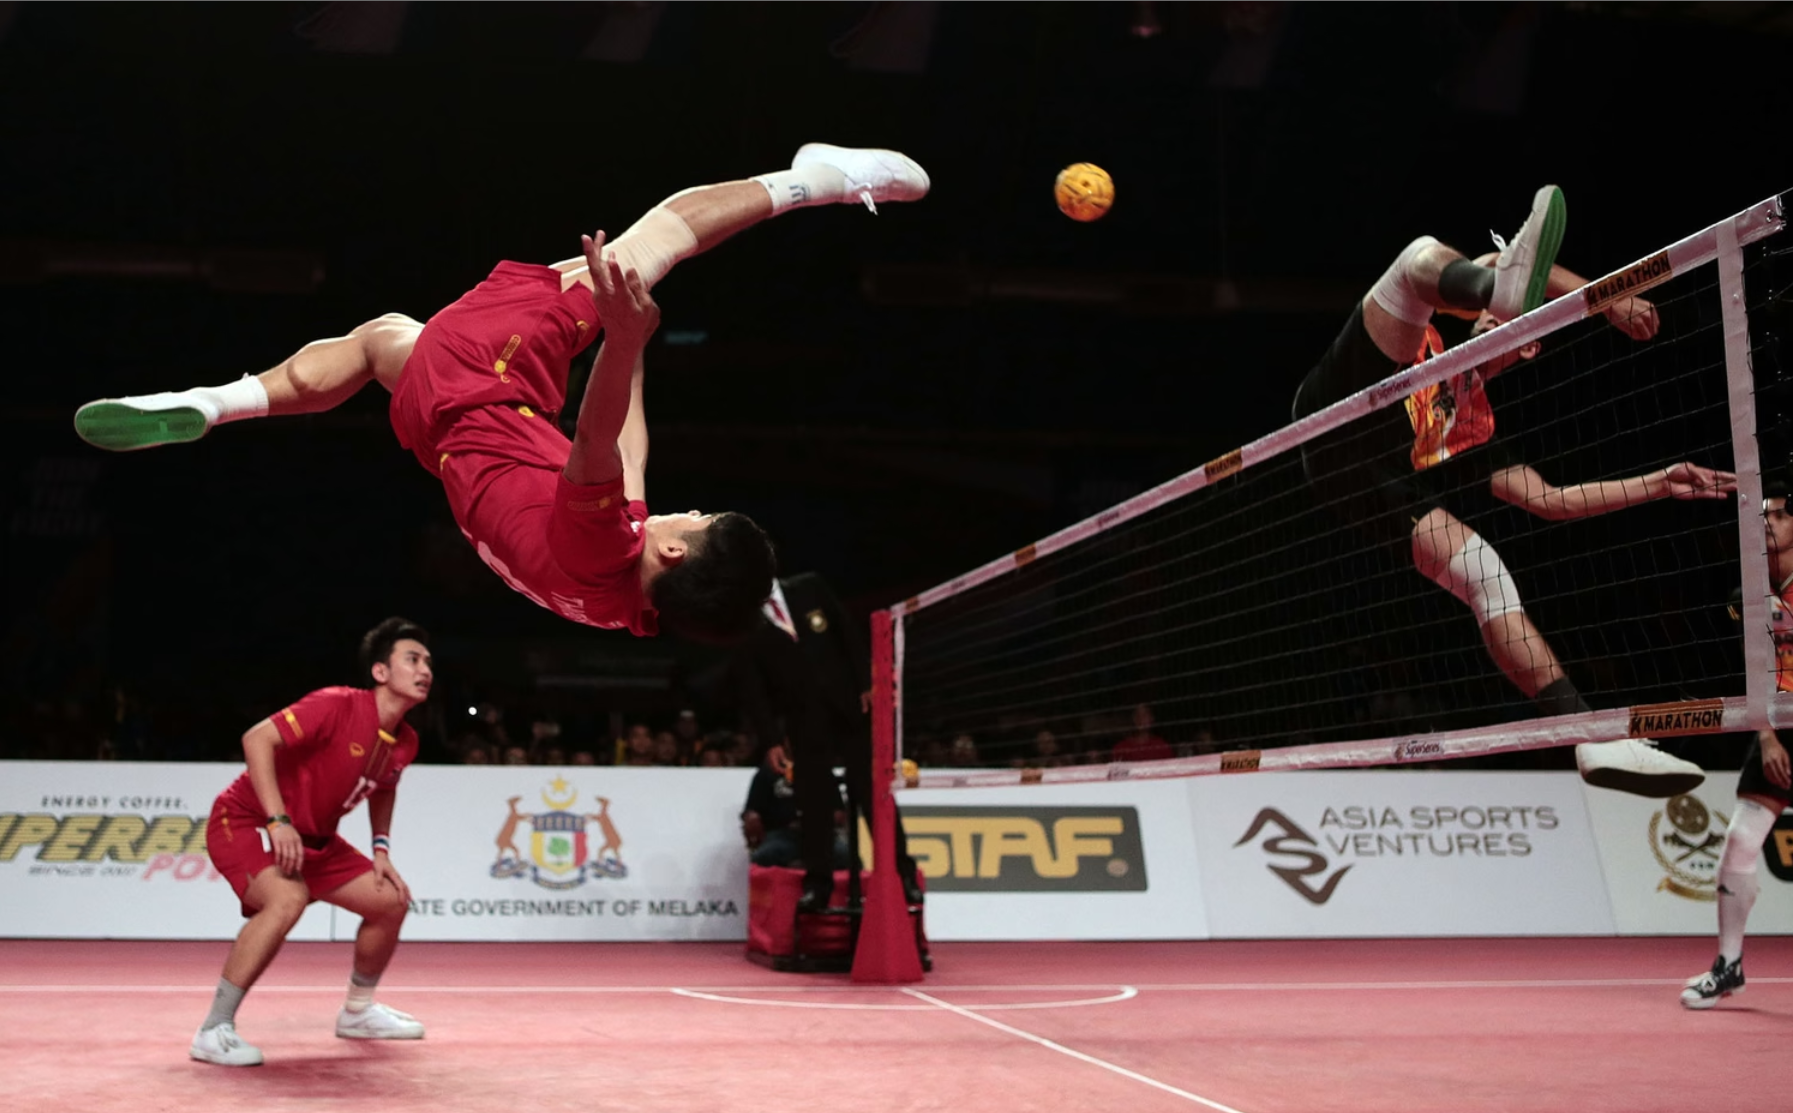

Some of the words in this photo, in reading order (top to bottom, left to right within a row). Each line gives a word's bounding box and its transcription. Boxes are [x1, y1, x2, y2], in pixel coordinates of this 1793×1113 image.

[1600, 256, 1671, 301] MARATHON
[1644, 710, 1722, 732] MARATHON
[1319, 806, 1403, 829] ASIA
[1410, 806, 1560, 830] SPORTS
[0, 813, 209, 863] PERB
[1325, 833, 1532, 857] VENTURES
[142, 853, 223, 881] PO
[408, 900, 445, 915] ATE
[451, 900, 605, 916] GOVERNMENT
[612, 900, 641, 916] OF
[648, 900, 740, 916] MELAKA
